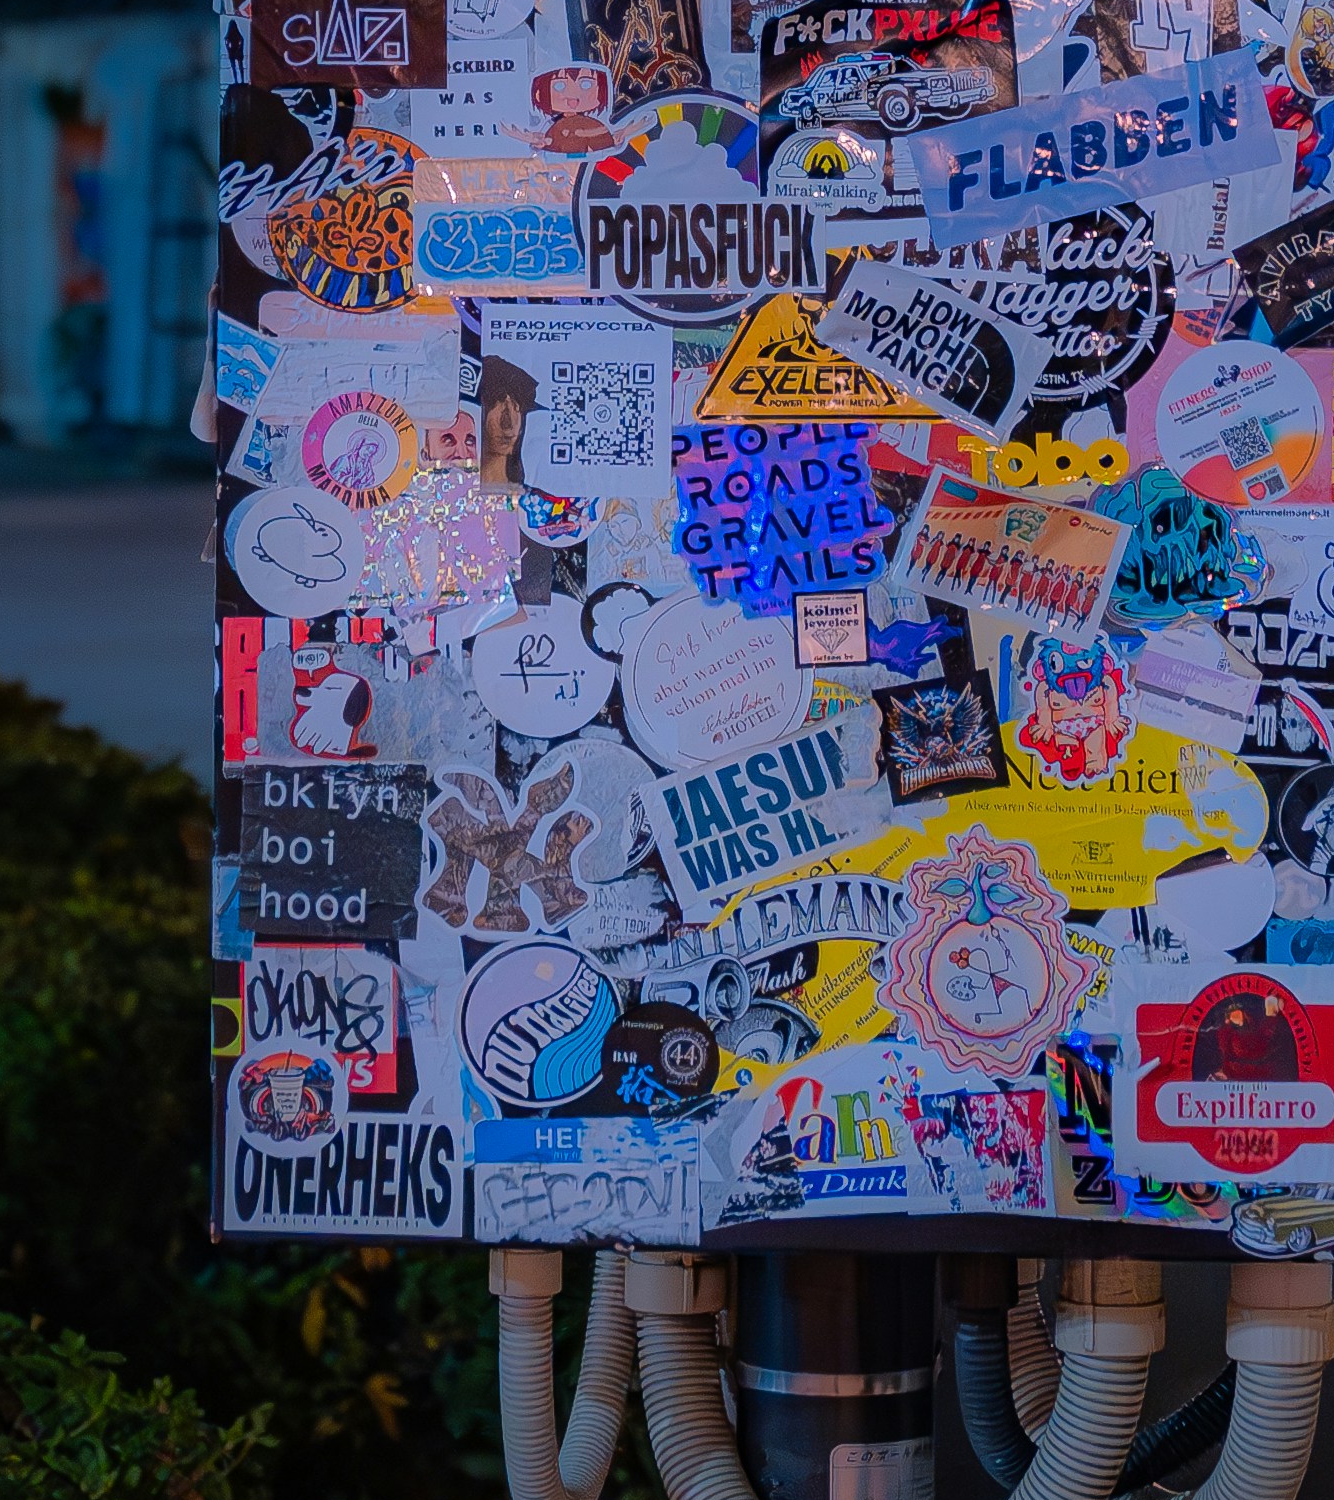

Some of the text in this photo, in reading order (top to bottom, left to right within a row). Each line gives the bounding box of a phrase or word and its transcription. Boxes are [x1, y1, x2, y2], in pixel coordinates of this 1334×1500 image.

[447, 58, 515, 73] CKBIRD
[775, 183, 878, 205] Mirai Walking
[589, 203, 818, 290] POPASFUCK
[1046, 216, 1152, 271] lack
[490, 320, 656, 332] В РАЮ ИСКУССТВА
[490, 331, 572, 342] НЕ БУДЕТ
[864, 327, 951, 392] YANG
[306, 462, 392, 510] MADONNA
[686, 453, 862, 512] ROADS
[681, 496, 885, 555] GRAVEL
[697, 541, 877, 599] TRAILS
[802, 605, 859, 617] kölmel
[653, 632, 776, 705] aber waren Sie
[666, 655, 776, 719] schon mal im
[264, 770, 399, 820] bklyn
[993, 802, 1024, 813] waren
[1044, 802, 1076, 815] schon
[261, 827, 336, 866] boi
[679, 822, 780, 892] WAS
[259, 883, 367, 924] hood
[612, 1050, 638, 1064] BAR
[669, 1044, 698, 1066] 44
[1176, 1090, 1317, 1126] Expilfarro
